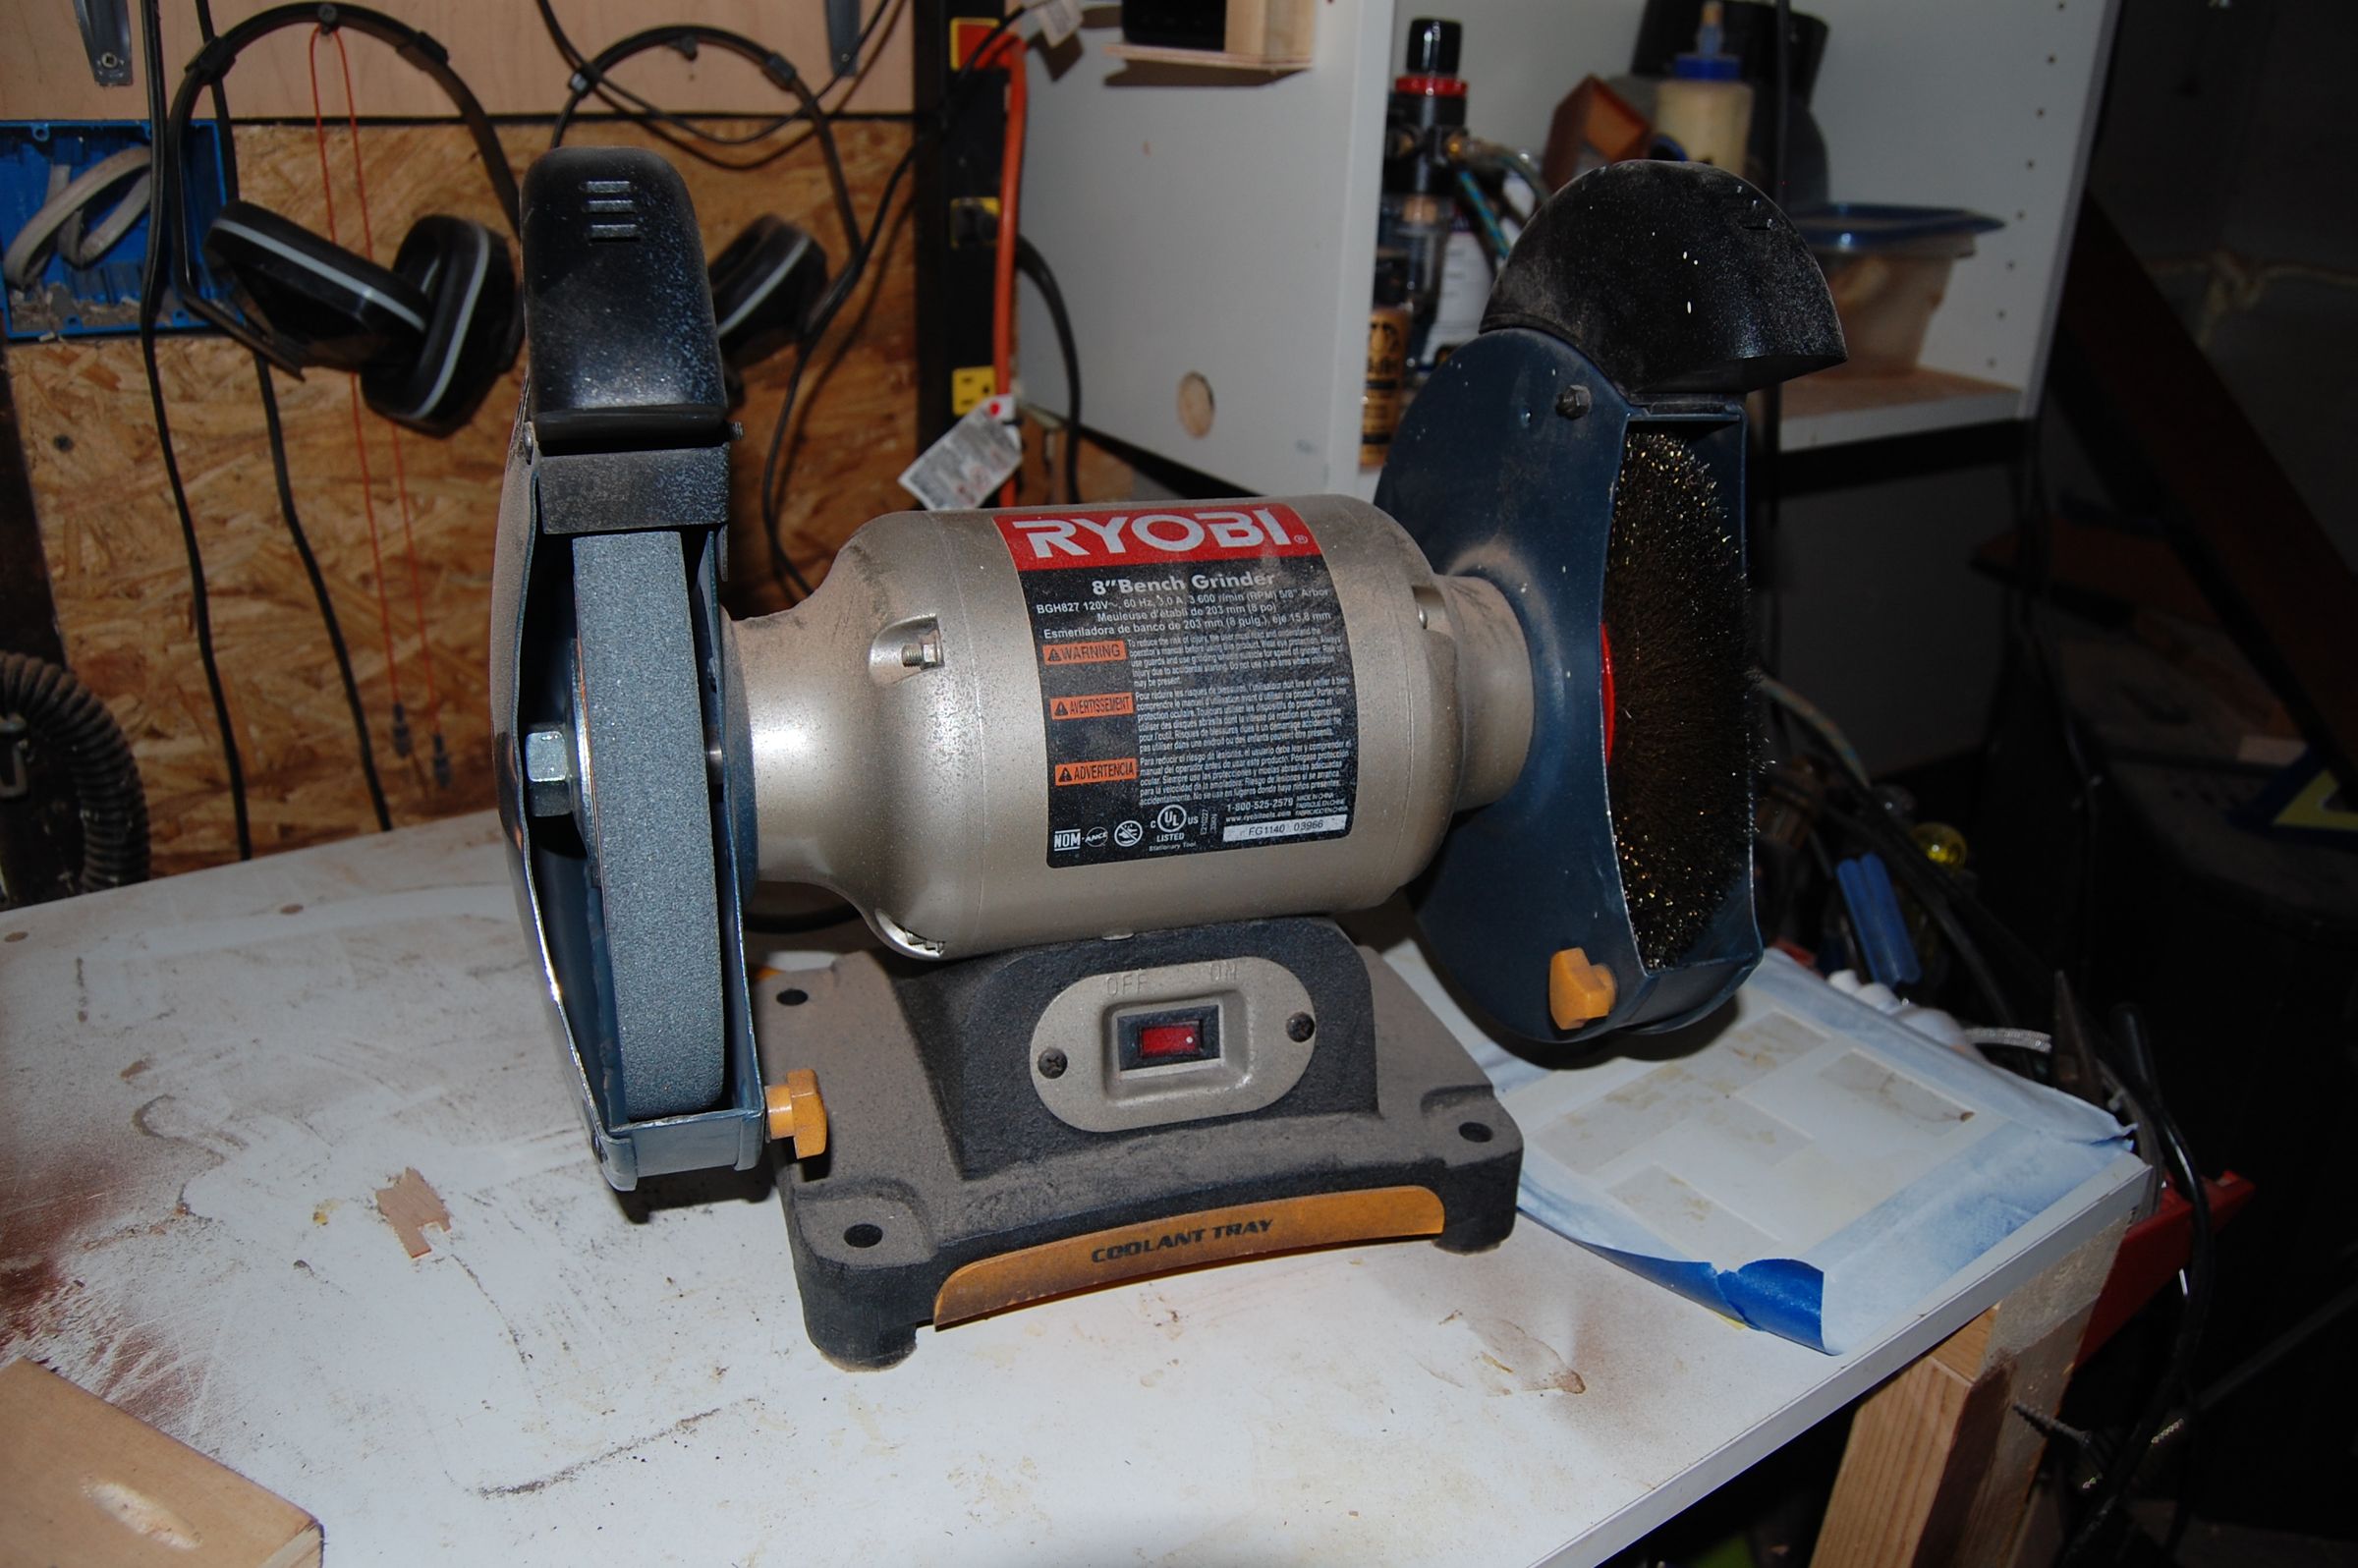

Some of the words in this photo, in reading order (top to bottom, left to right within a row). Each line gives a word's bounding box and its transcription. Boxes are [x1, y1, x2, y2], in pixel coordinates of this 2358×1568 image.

[1014, 508, 1291, 558] RYOBI
[1191, 570, 1275, 590] Grinder
[1037, 603, 1079, 614] BGH827
[1124, 598, 1136, 608] 60
[1246, 589, 1276, 601] (RPM)
[1301, 588, 1327, 596] Arbor
[1097, 612, 1148, 623] Meuleuse
[1191, 606, 1203, 616] de
[1206, 605, 1223, 615] 203
[1226, 605, 1245, 614] mm
[1248, 603, 1258, 614] (8
[1260, 602, 1276, 614] po)
[1043, 625, 1114, 639] Esmeriladora
[1118, 623, 1130, 635] de
[1133, 621, 1164, 633] banco
[1168, 620, 1180, 630] de
[1184, 619, 1202, 629] 203
[1205, 618, 1223, 628] mm
[1226, 616, 1235, 628] (8
[1272, 614, 1286, 625] eje
[1313, 611, 1330, 621] mm
[1060, 644, 1120, 660] WARNING
[1069, 697, 1130, 715] AVERTISSEMENT
[1074, 764, 1134, 781] ADVERTENCIA
[1228, 797, 1293, 812] 1-800-525-2579
[1188, 815, 1199, 825] US
[1248, 823, 1285, 836] FG1140
[1293, 820, 1323, 832] 03966
[1054, 832, 1080, 848] NOM
[1085, 831, 1108, 843] ANCE
[1156, 832, 1184, 843] LISTED
[1149, 843, 1180, 852] Stationary
[1105, 972, 1148, 997] OFF
[1091, 1228, 1207, 1263] COOLANT
[1211, 1219, 1273, 1240] TRAY
